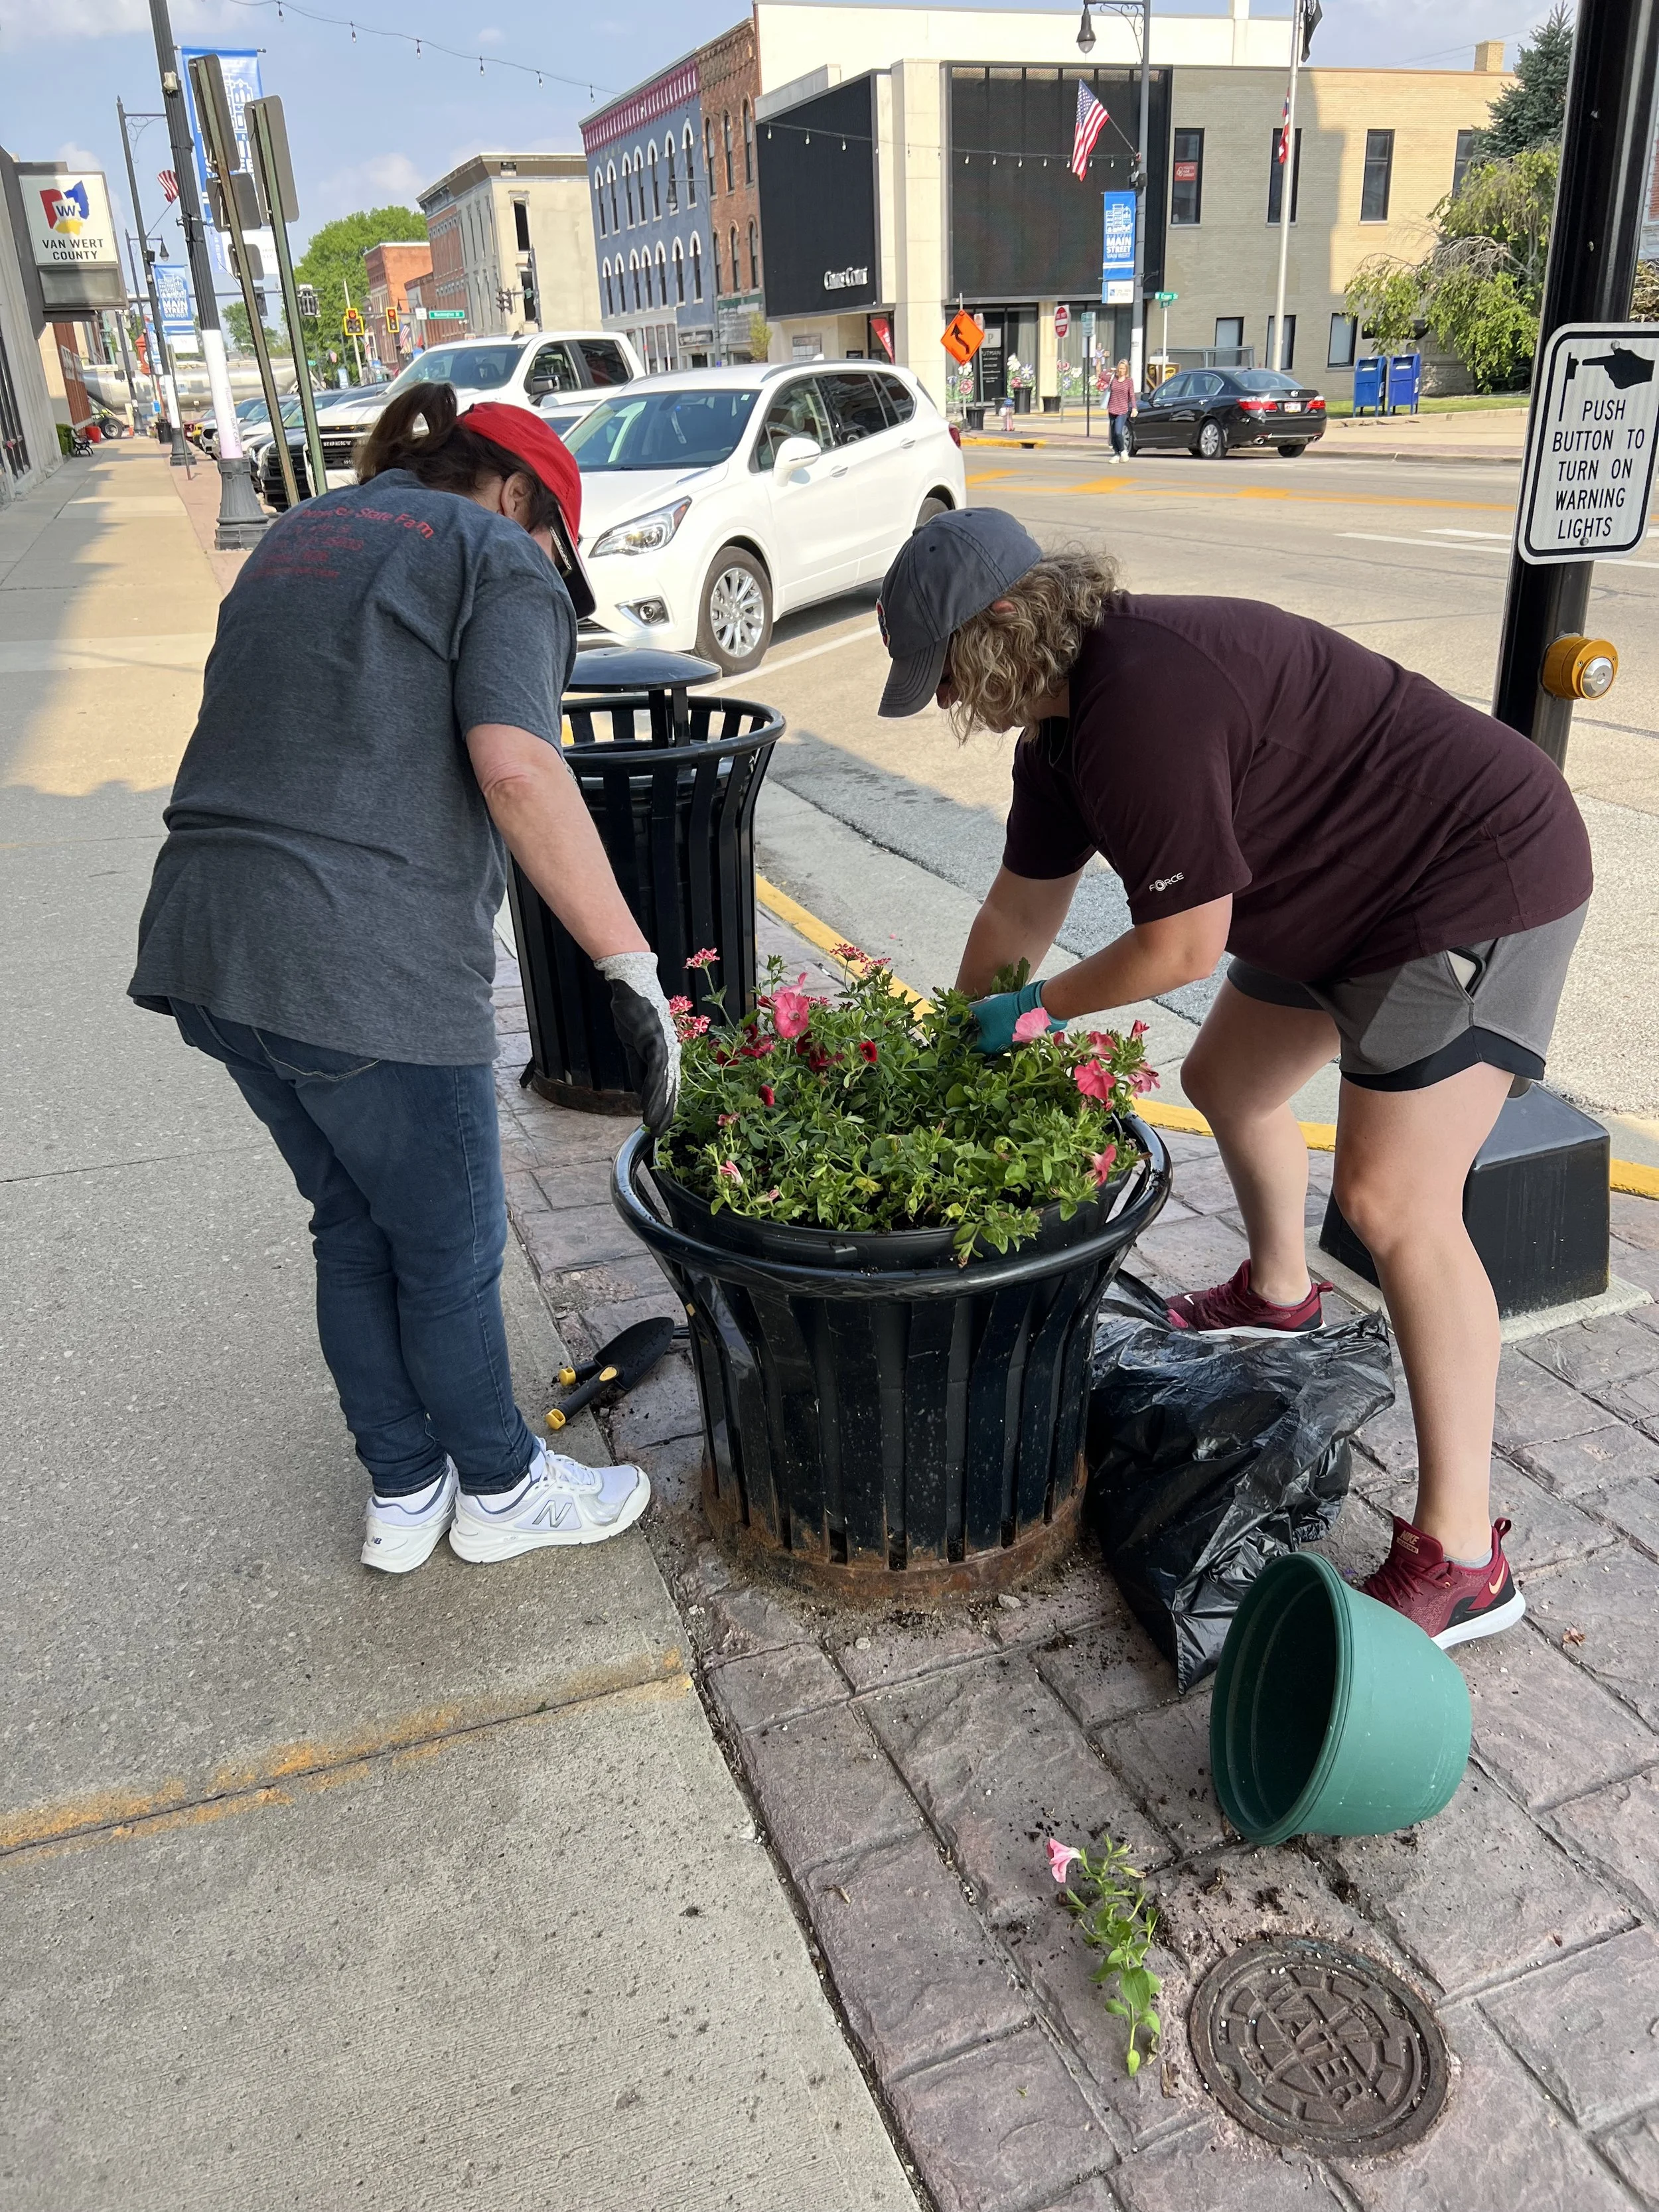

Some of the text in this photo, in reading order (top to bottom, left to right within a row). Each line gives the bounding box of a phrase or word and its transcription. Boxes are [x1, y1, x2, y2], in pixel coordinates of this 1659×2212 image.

[56, 205, 76, 217] VW
[42, 239, 104, 249] VAN WERT
[1106, 238, 1132, 246] MAIN
[52, 251, 98, 260] COUNTY
[162, 300, 188, 309] MAIN
[987, 333, 993, 344] P
[1582, 400, 1626, 421] PUSH
[1552, 429, 1644, 452] BUTTON TO
[1559, 459, 1632, 482] TURN ON
[1555, 488, 1626, 510] WARNING
[1557, 516, 1613, 540] LIGHTS
[1149, 871, 1185, 892] FORCE
[370, 1536, 382, 1544] NB
[1400, 1530, 1420, 1545] NIKE
[1265, 1980, 1368, 2112] WATER
